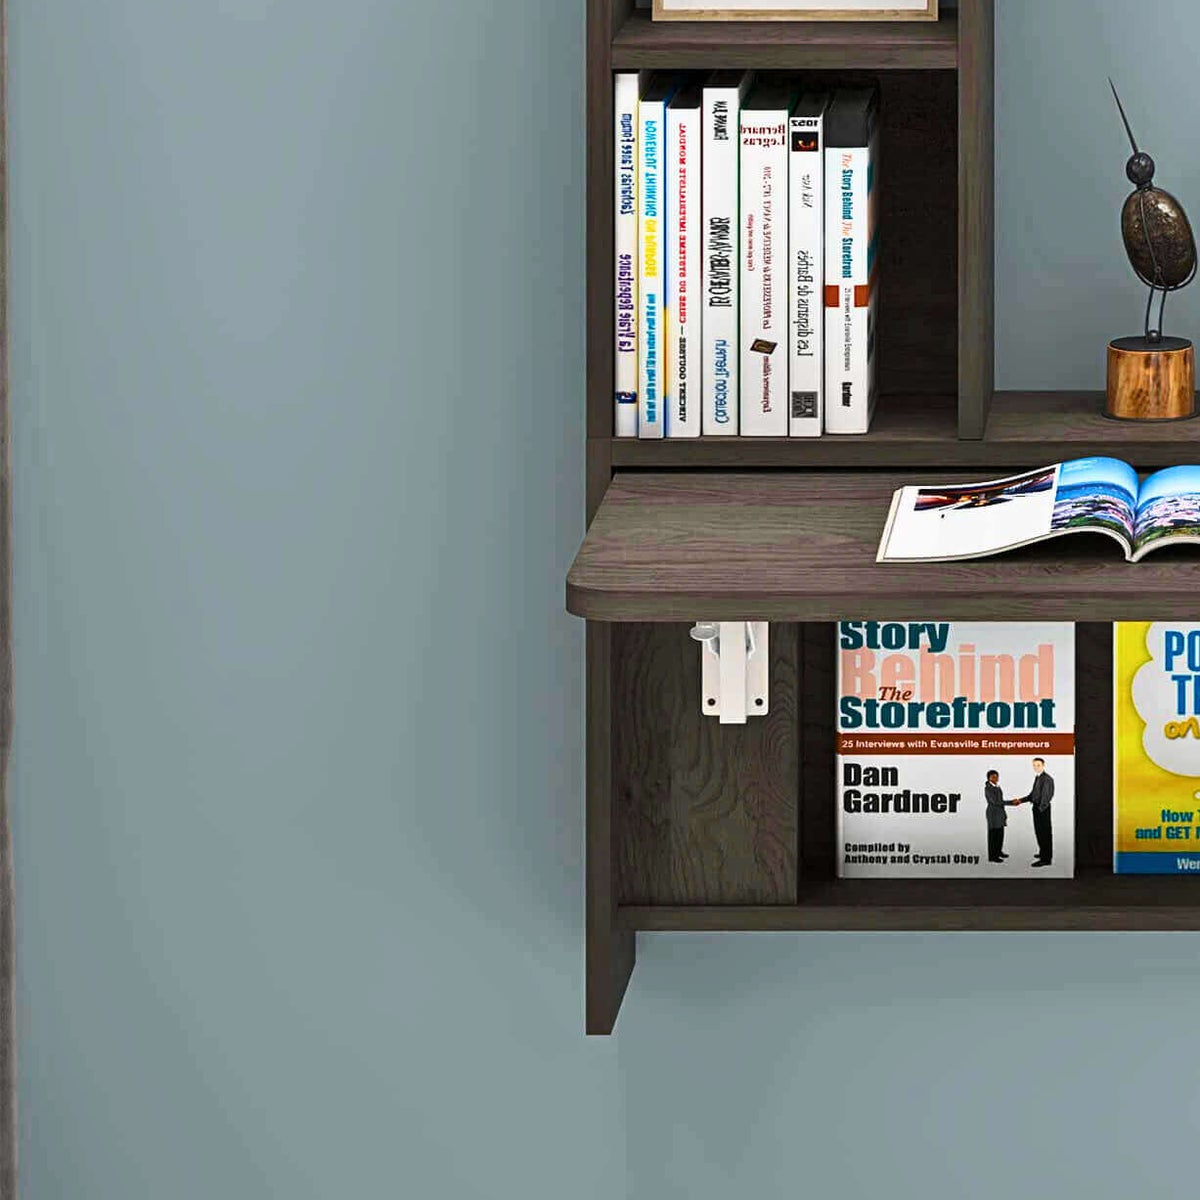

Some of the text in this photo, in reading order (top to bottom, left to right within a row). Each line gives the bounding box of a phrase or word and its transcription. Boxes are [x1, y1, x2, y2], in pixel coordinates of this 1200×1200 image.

[841, 153, 853, 278] The Story Behind The Storefront
[840, 621, 949, 652] Story
[841, 644, 1054, 702] Behind
[878, 686, 912, 701] The
[840, 696, 1056, 729] Storefront
[1164, 717, 1200, 740] on
[842, 739, 1050, 750] 25 Interviews with Evansville Entrepreneurs
[843, 763, 898, 786] Dan
[843, 790, 961, 813] Gardner
[1162, 809, 1194, 823] How
[1135, 826, 1161, 840] and
[1165, 826, 1191, 840] GET
[844, 843, 910, 854] Compiled by
[844, 854, 887, 864] Anthony
[890, 854, 910, 864] and
[913, 854, 951, 864] Crystal
